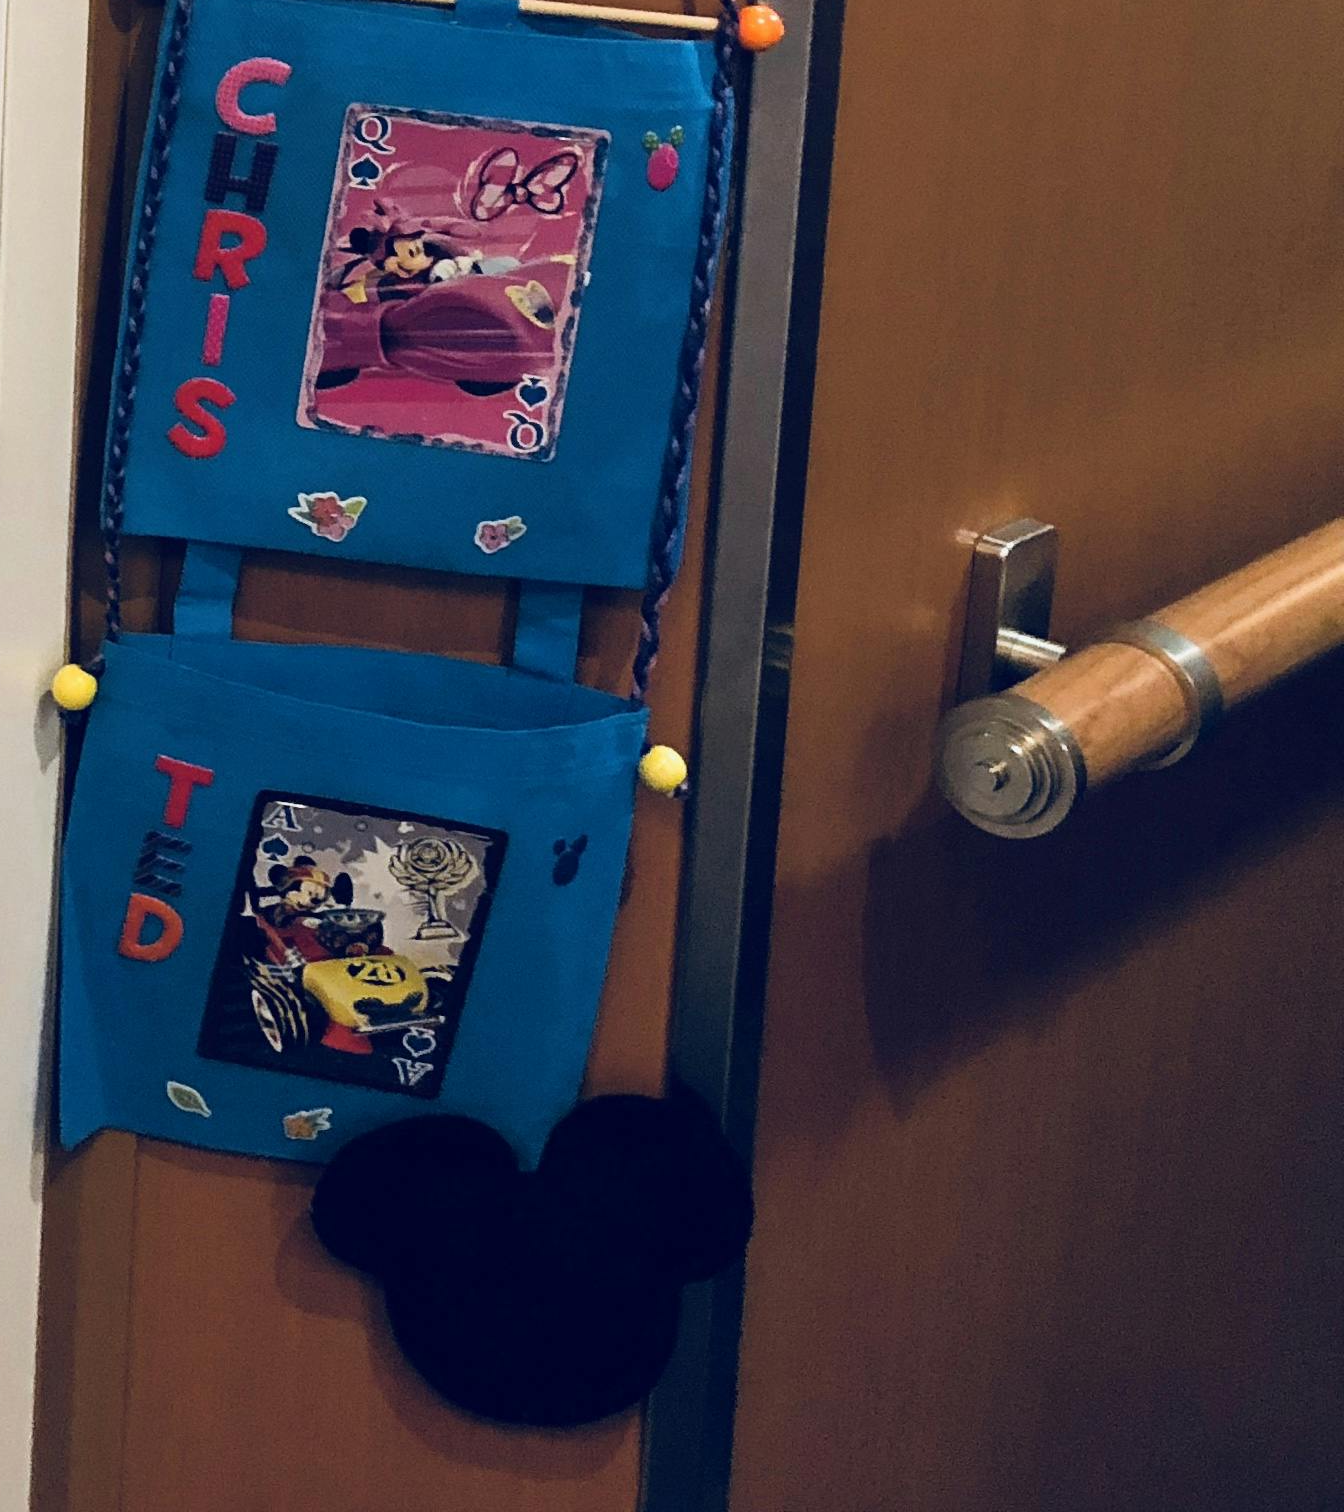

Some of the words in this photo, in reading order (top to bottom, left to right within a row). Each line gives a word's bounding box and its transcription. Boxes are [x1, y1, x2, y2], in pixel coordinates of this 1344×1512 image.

[353, 114, 395, 153] Q
[167, 56, 291, 457] CHRIS
[503, 410, 546, 453] Q
[261, 804, 301, 832] A
[118, 754, 214, 962] TED
[392, 1057, 434, 1086] A
